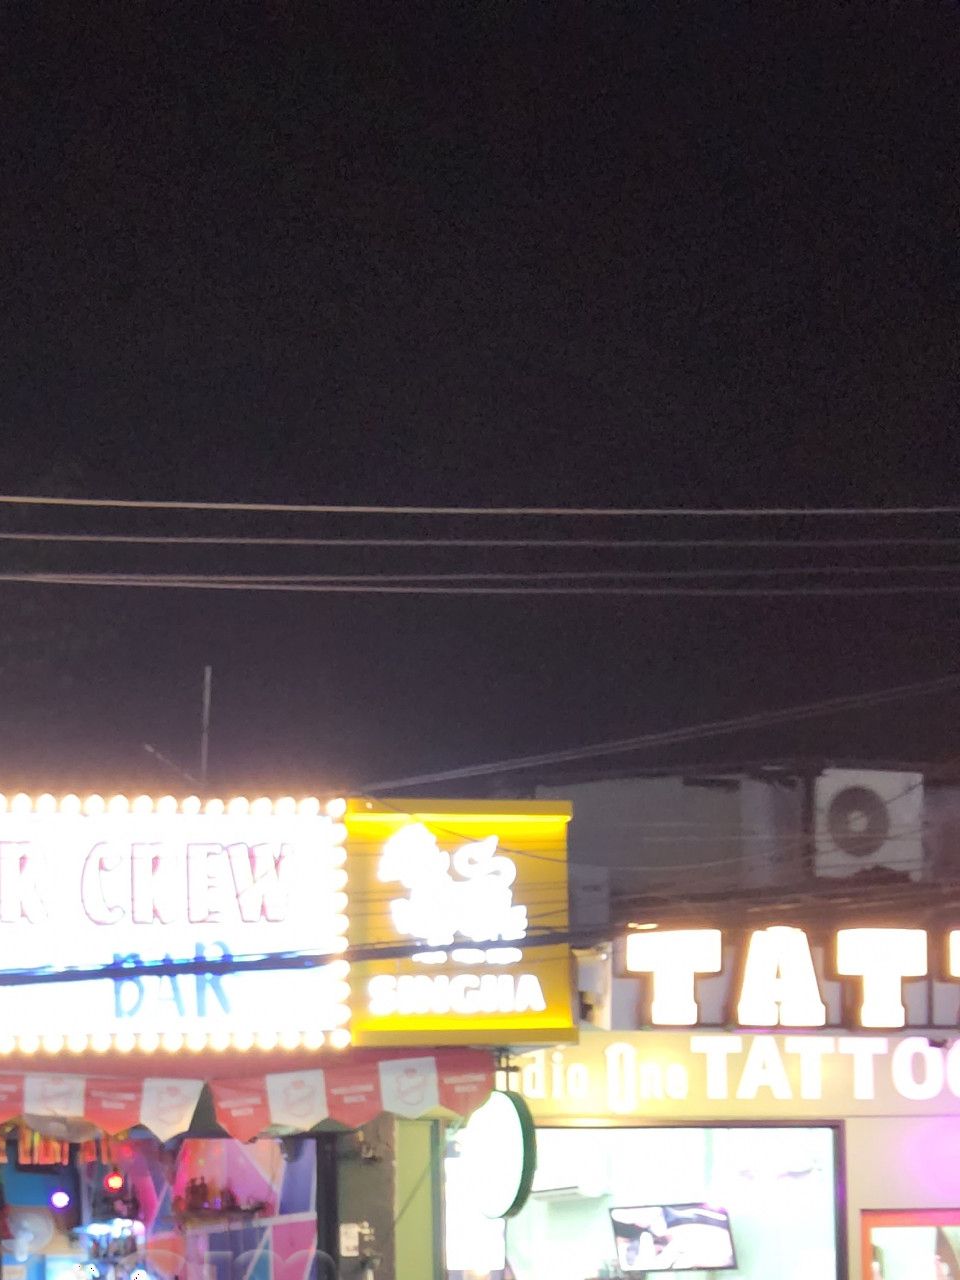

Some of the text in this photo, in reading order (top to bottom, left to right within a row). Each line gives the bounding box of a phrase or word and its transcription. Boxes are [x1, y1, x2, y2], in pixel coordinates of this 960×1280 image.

[81, 841, 293, 926] CREW
[112, 941, 232, 1019] BAR
[367, 973, 547, 1015] SINGHA
[626, 925, 960, 1028] TAT
[605, 1042, 690, 1114] One
